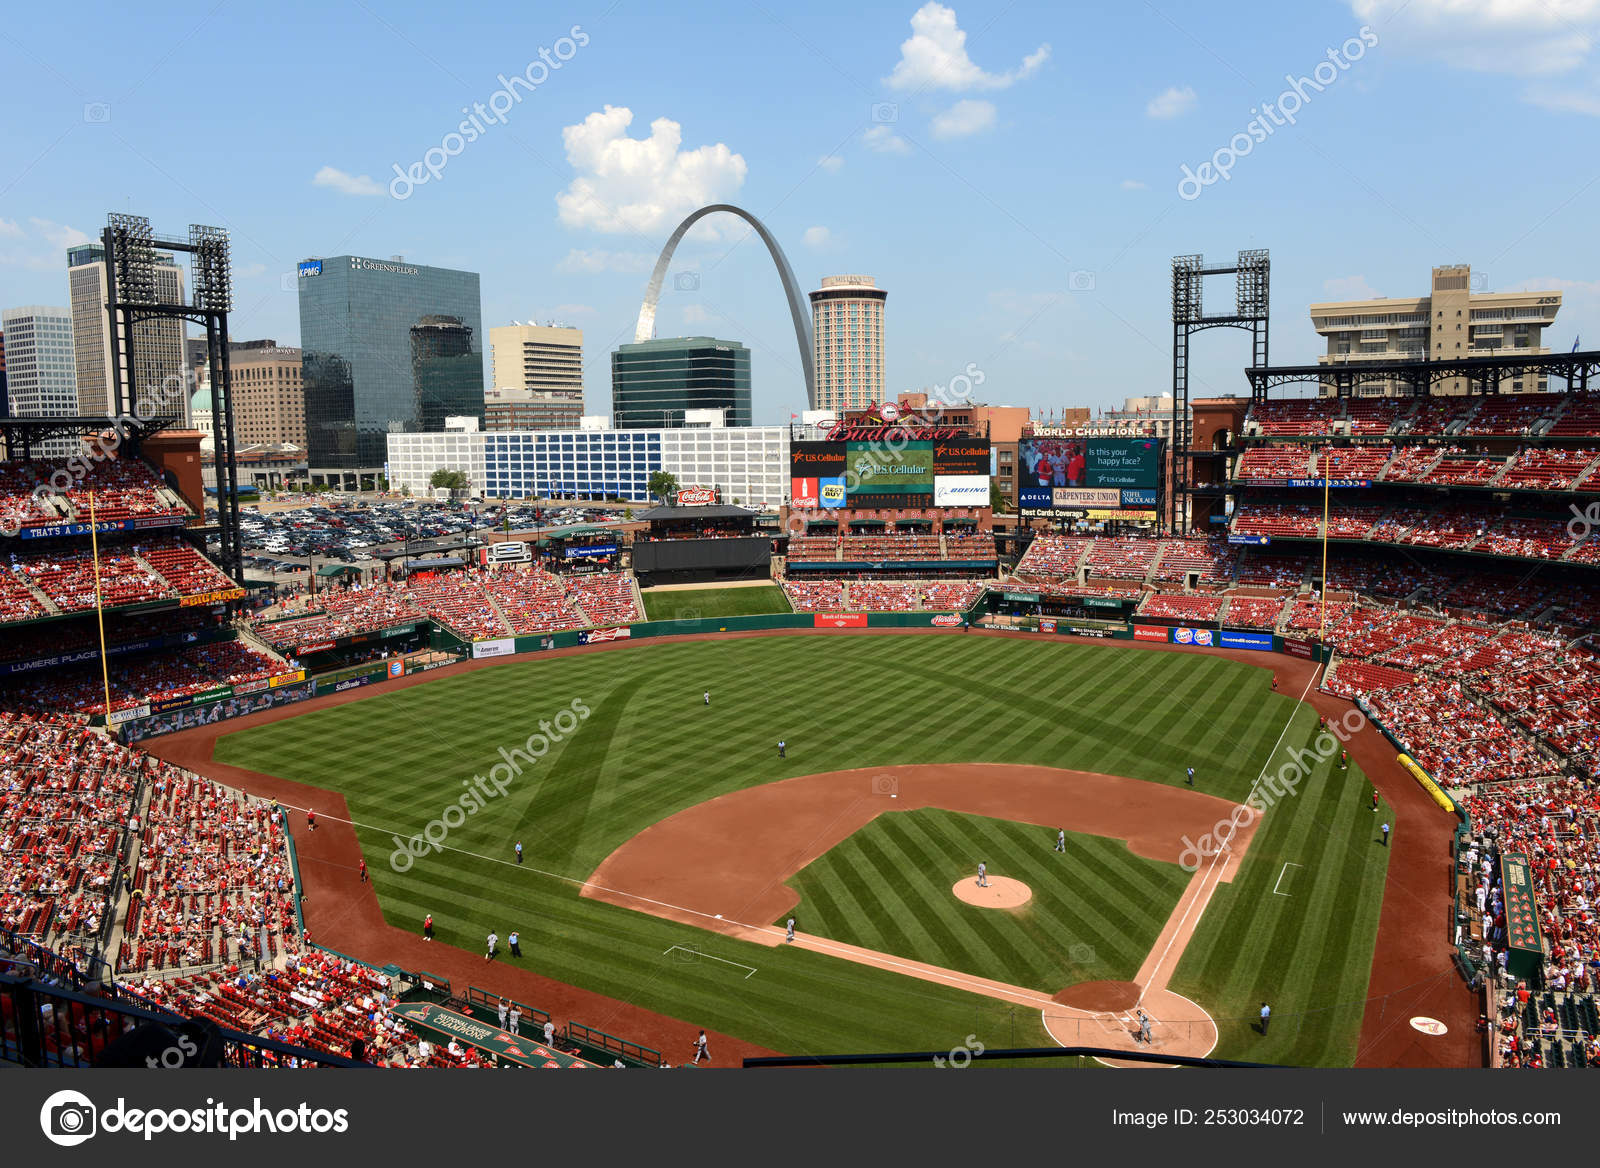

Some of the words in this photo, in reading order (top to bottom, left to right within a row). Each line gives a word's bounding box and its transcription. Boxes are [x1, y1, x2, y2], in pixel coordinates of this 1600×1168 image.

[298, 266, 320, 278] KPMG
[1033, 428, 1073, 437] WORLD
[1075, 427, 1144, 436] CHAMPIONS
[961, 447, 990, 456] Cellular
[1089, 448, 1095, 456] Is
[1096, 447, 1110, 456] this
[1111, 449, 1128, 458] your
[817, 453, 846, 462] Cellular
[1097, 457, 1120, 466] happy
[1122, 457, 1141, 465] face?
[888, 464, 926, 475] Cellular
[1097, 491, 1118, 501] UNION
[1021, 508, 1035, 516] Best
[1036, 509, 1053, 517] Cards
[1055, 510, 1084, 519] Coverage
[30, 527, 61, 538] THAT'S
[65, 527, 72, 535] A
[211, 589, 240, 601] MAC
[11, 657, 59, 672] LUMIERE
[61, 650, 98, 663] PLACE
[437, 1012, 468, 1027] NATIONAL
[433, 1016, 487, 1041] CHAMPIONS
